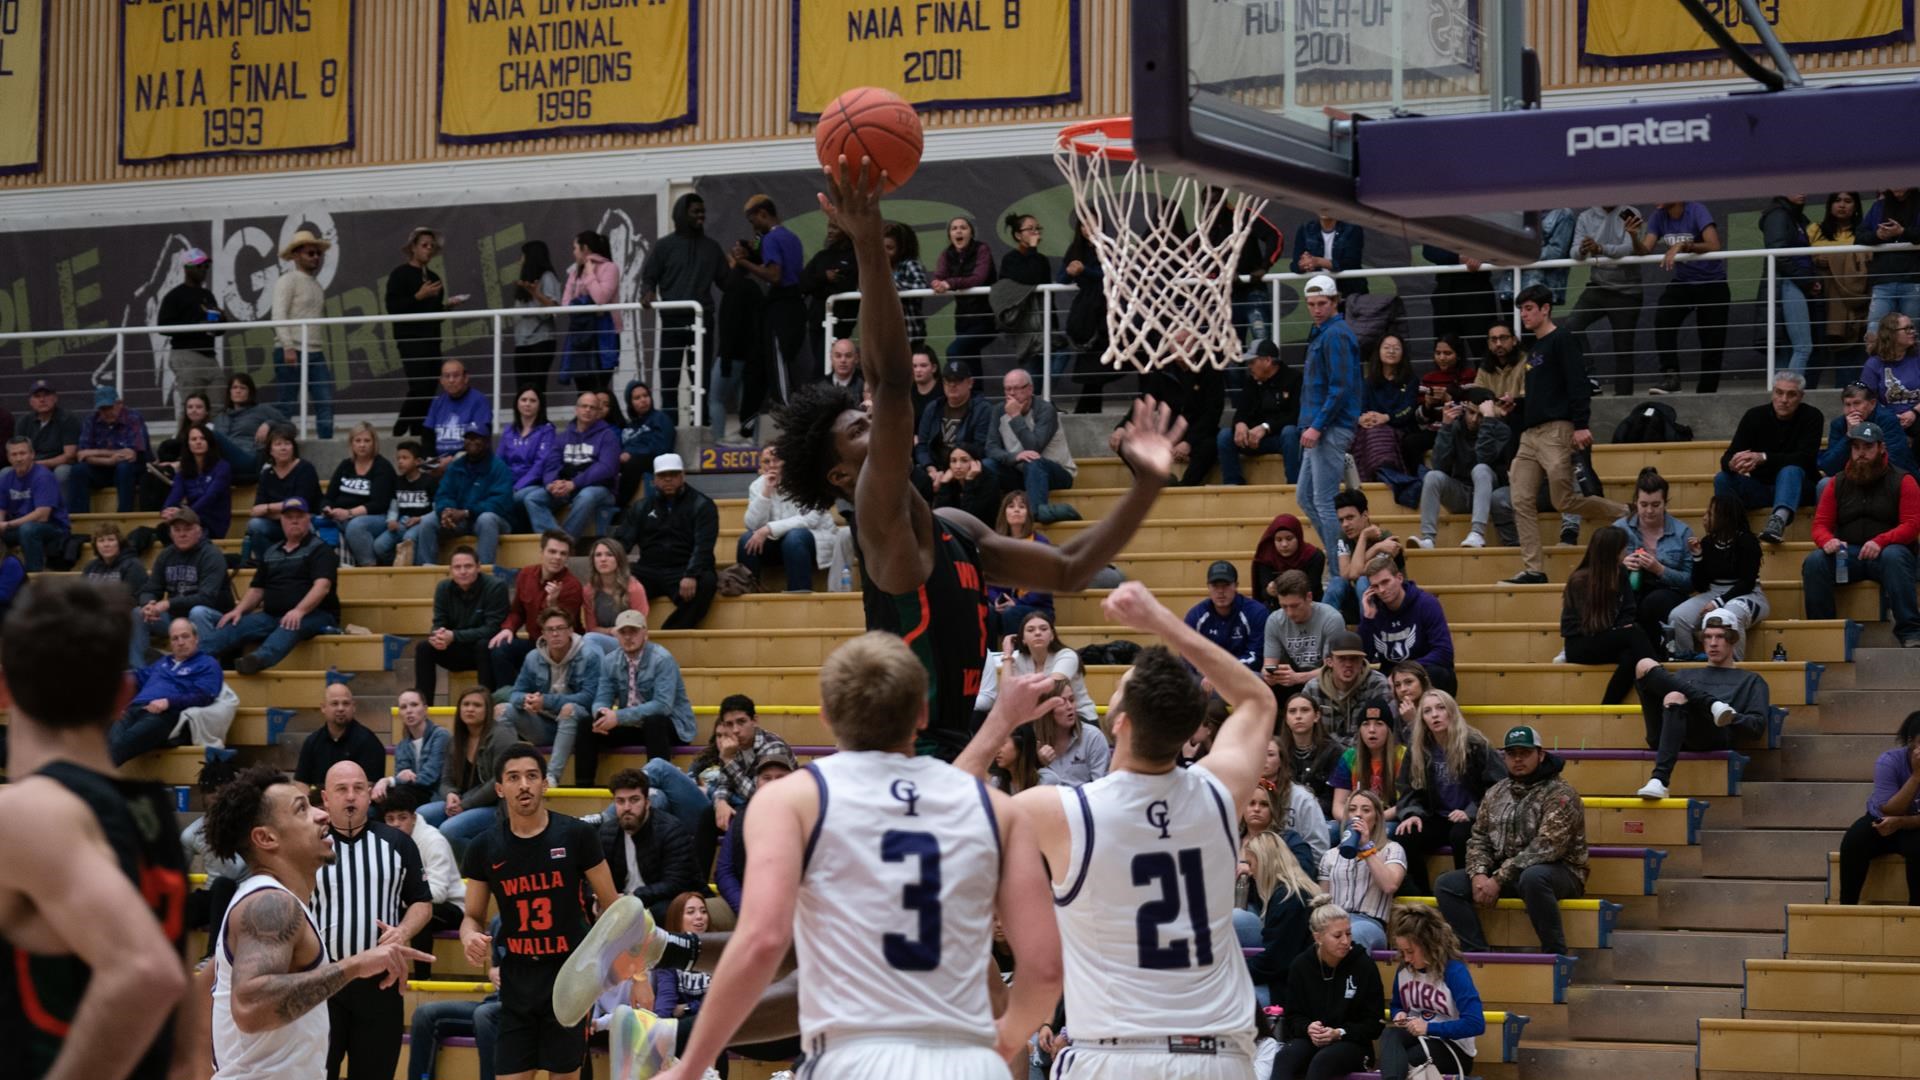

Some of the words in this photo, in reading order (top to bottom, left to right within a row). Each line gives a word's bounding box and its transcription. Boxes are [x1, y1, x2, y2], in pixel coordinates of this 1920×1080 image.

[163, 0, 311, 43] CHAMPIONS
[508, 16, 623, 56] NATIONAL
[848, 6, 903, 42] NAIA
[916, 0, 990, 35] FINAL
[231, 41, 240, 60] &
[904, 49, 961, 83] 2001
[1294, 32, 1352, 67] 2001
[135, 69, 206, 112] NAIA
[229, 61, 307, 103] FINAL
[320, 59, 337, 97] 8
[500, 52, 632, 92] CHAMPIONS
[536, 89, 592, 122] 1996
[203, 107, 263, 147] 1993
[222, 205, 339, 321] GO
[702, 449, 717, 468] 2
[722, 451, 758, 467] SECT
[500, 870, 564, 896] WALLA
[881, 830, 942, 971] 3
[516, 897, 552, 931] 13
[1131, 848, 1213, 969] 21
[507, 936, 569, 955] WALLA
[1400, 980, 1450, 1017] CUBS
